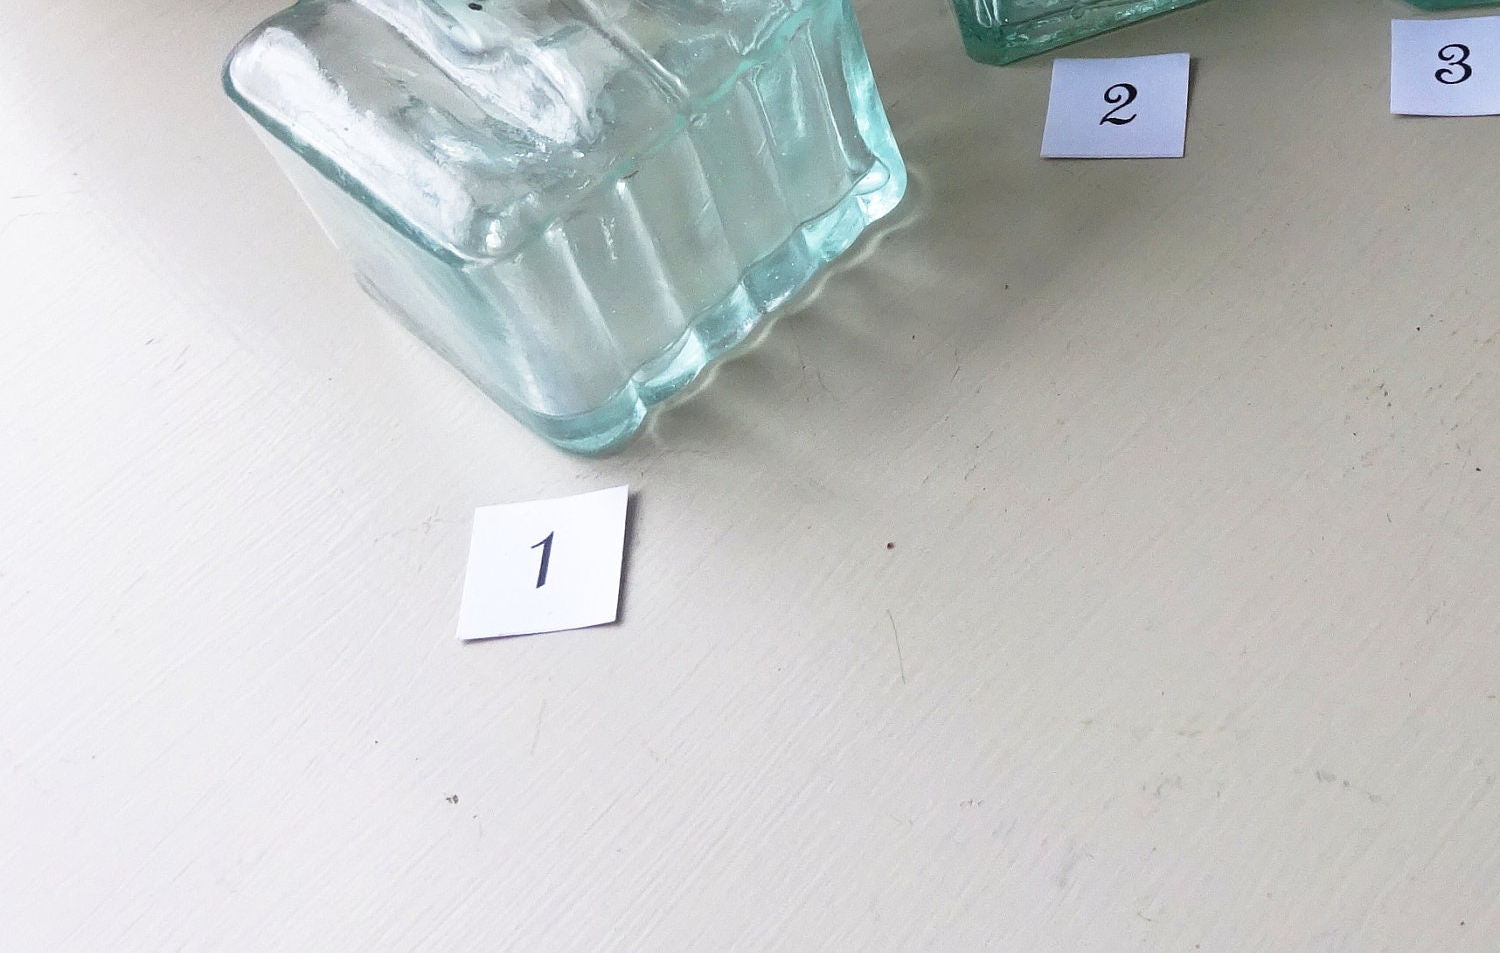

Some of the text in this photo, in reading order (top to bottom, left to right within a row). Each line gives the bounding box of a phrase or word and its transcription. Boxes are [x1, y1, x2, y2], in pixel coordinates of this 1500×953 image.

[1434, 43, 1473, 86] 3
[1099, 83, 1138, 127] 2
[530, 531, 554, 590] 1
